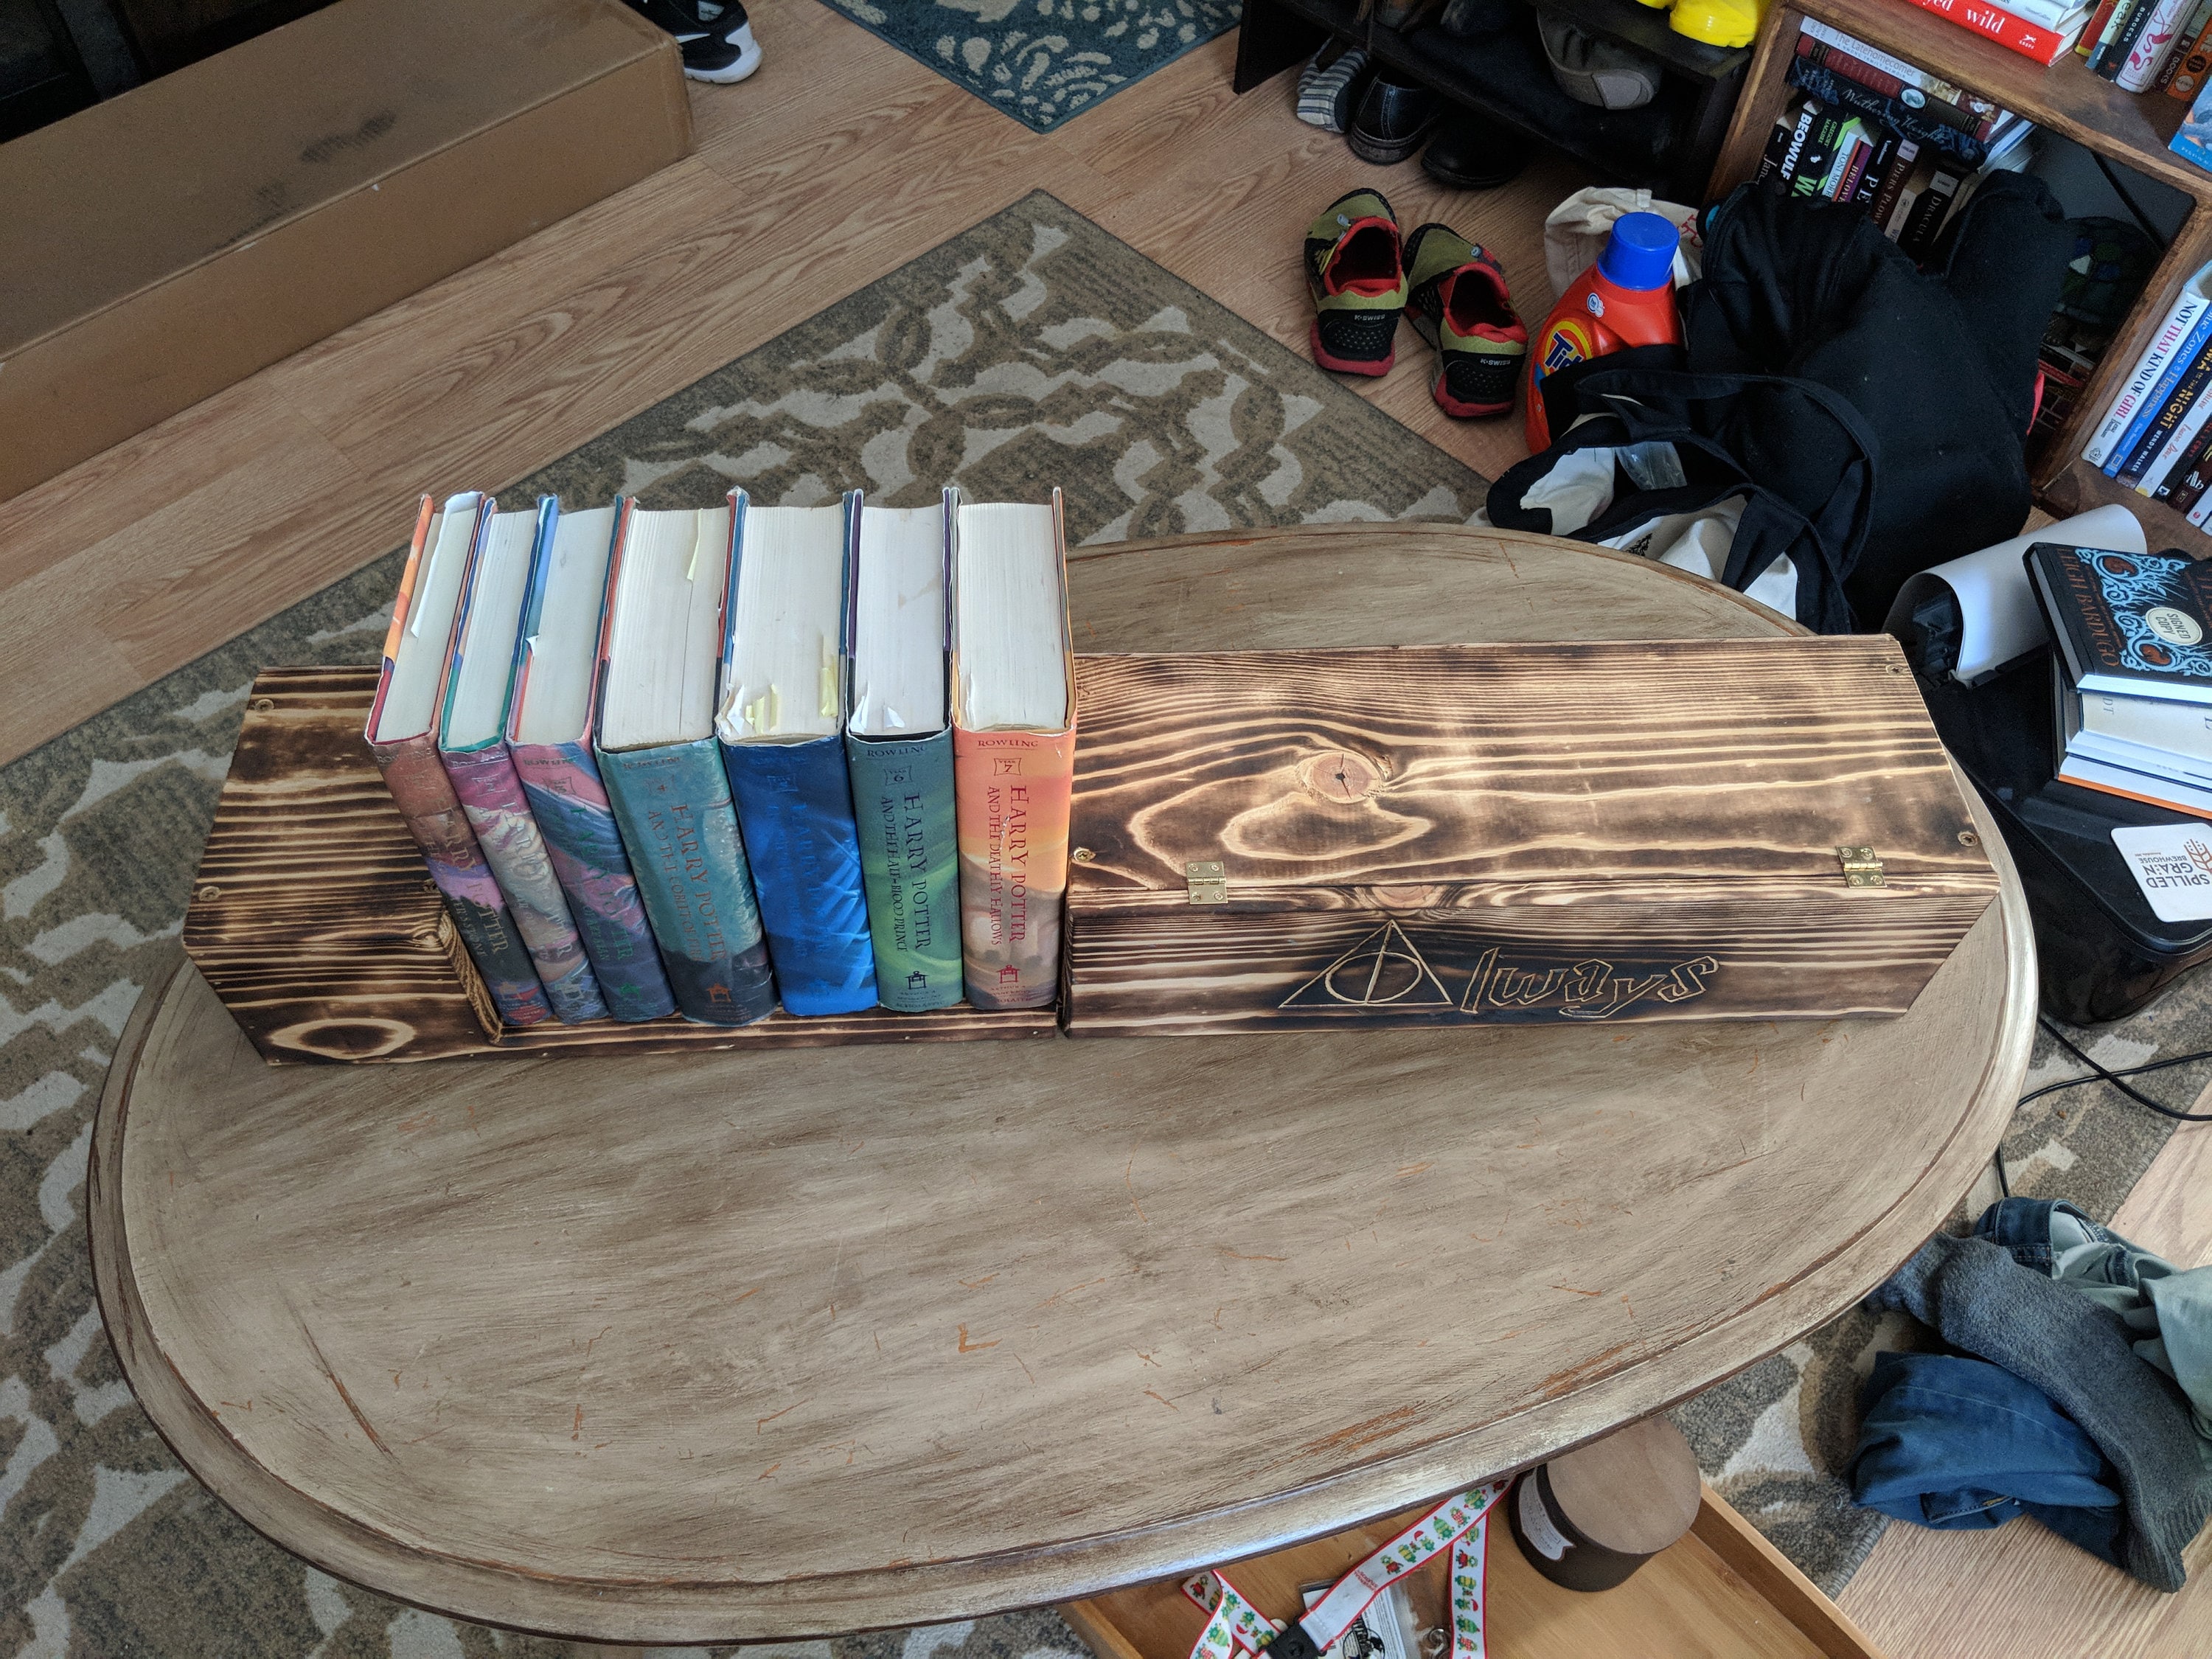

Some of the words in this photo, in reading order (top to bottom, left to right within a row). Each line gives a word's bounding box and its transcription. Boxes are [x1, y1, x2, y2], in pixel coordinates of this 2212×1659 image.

[1966, 9, 2006, 34] wild
[2123, 7, 2146, 43] BURGESS
[1836, 32, 1850, 46] The
[1851, 39, 1915, 77] Latehomecomer
[1818, 118, 1830, 144] MAGUIRE
[1824, 121, 1837, 147] GREGORY
[1781, 113, 1812, 181] BEOWULF
[1837, 153, 1849, 172] TONI
[1887, 163, 1905, 191] PIERS
[1913, 195, 1942, 242] DRACULA
[2179, 300, 2198, 327] NOT
[2157, 324, 2180, 355] THAT
[2177, 331, 2205, 365] Zones
[2139, 352, 2164, 381] KIND
[2130, 380, 2146, 398] OF
[2143, 371, 2179, 418] Happiness
[2115, 394, 2137, 420] GIRL
[2160, 389, 2194, 429] NIGHT
[2146, 430, 2163, 451] WENDY
[2131, 450, 2149, 472] WALKER
[2057, 549, 2087, 589] LEIGH
[2075, 593, 2120, 667] BARDUGO
[2155, 616, 2175, 636] COPY
[2166, 612, 2191, 640] SIGNED
[867, 746, 928, 757] ROWLING
[978, 740, 1038, 748] ROWLING
[1004, 765, 1013, 773] 7
[880, 796, 896, 822] AND
[987, 786, 1001, 813] AND
[886, 824, 900, 849] THE
[904, 793, 928, 873] HARRY
[990, 815, 1001, 840] THE
[1009, 785, 1029, 867] HARRY
[647, 811, 668, 841] AND
[660, 844, 679, 872] THE
[988, 844, 1004, 894] DEATHLY
[2138, 855, 2188, 863] BREWHOUSE
[670, 804, 709, 883] HARRY
[695, 891, 728, 961] POTTER
[2146, 874, 2210, 888] SPILLED
[911, 879, 932, 950] POTTER
[990, 898, 1004, 945] HALLOWS
[1009, 874, 1027, 943] POTTER
[894, 917, 908, 951] PRINCE
